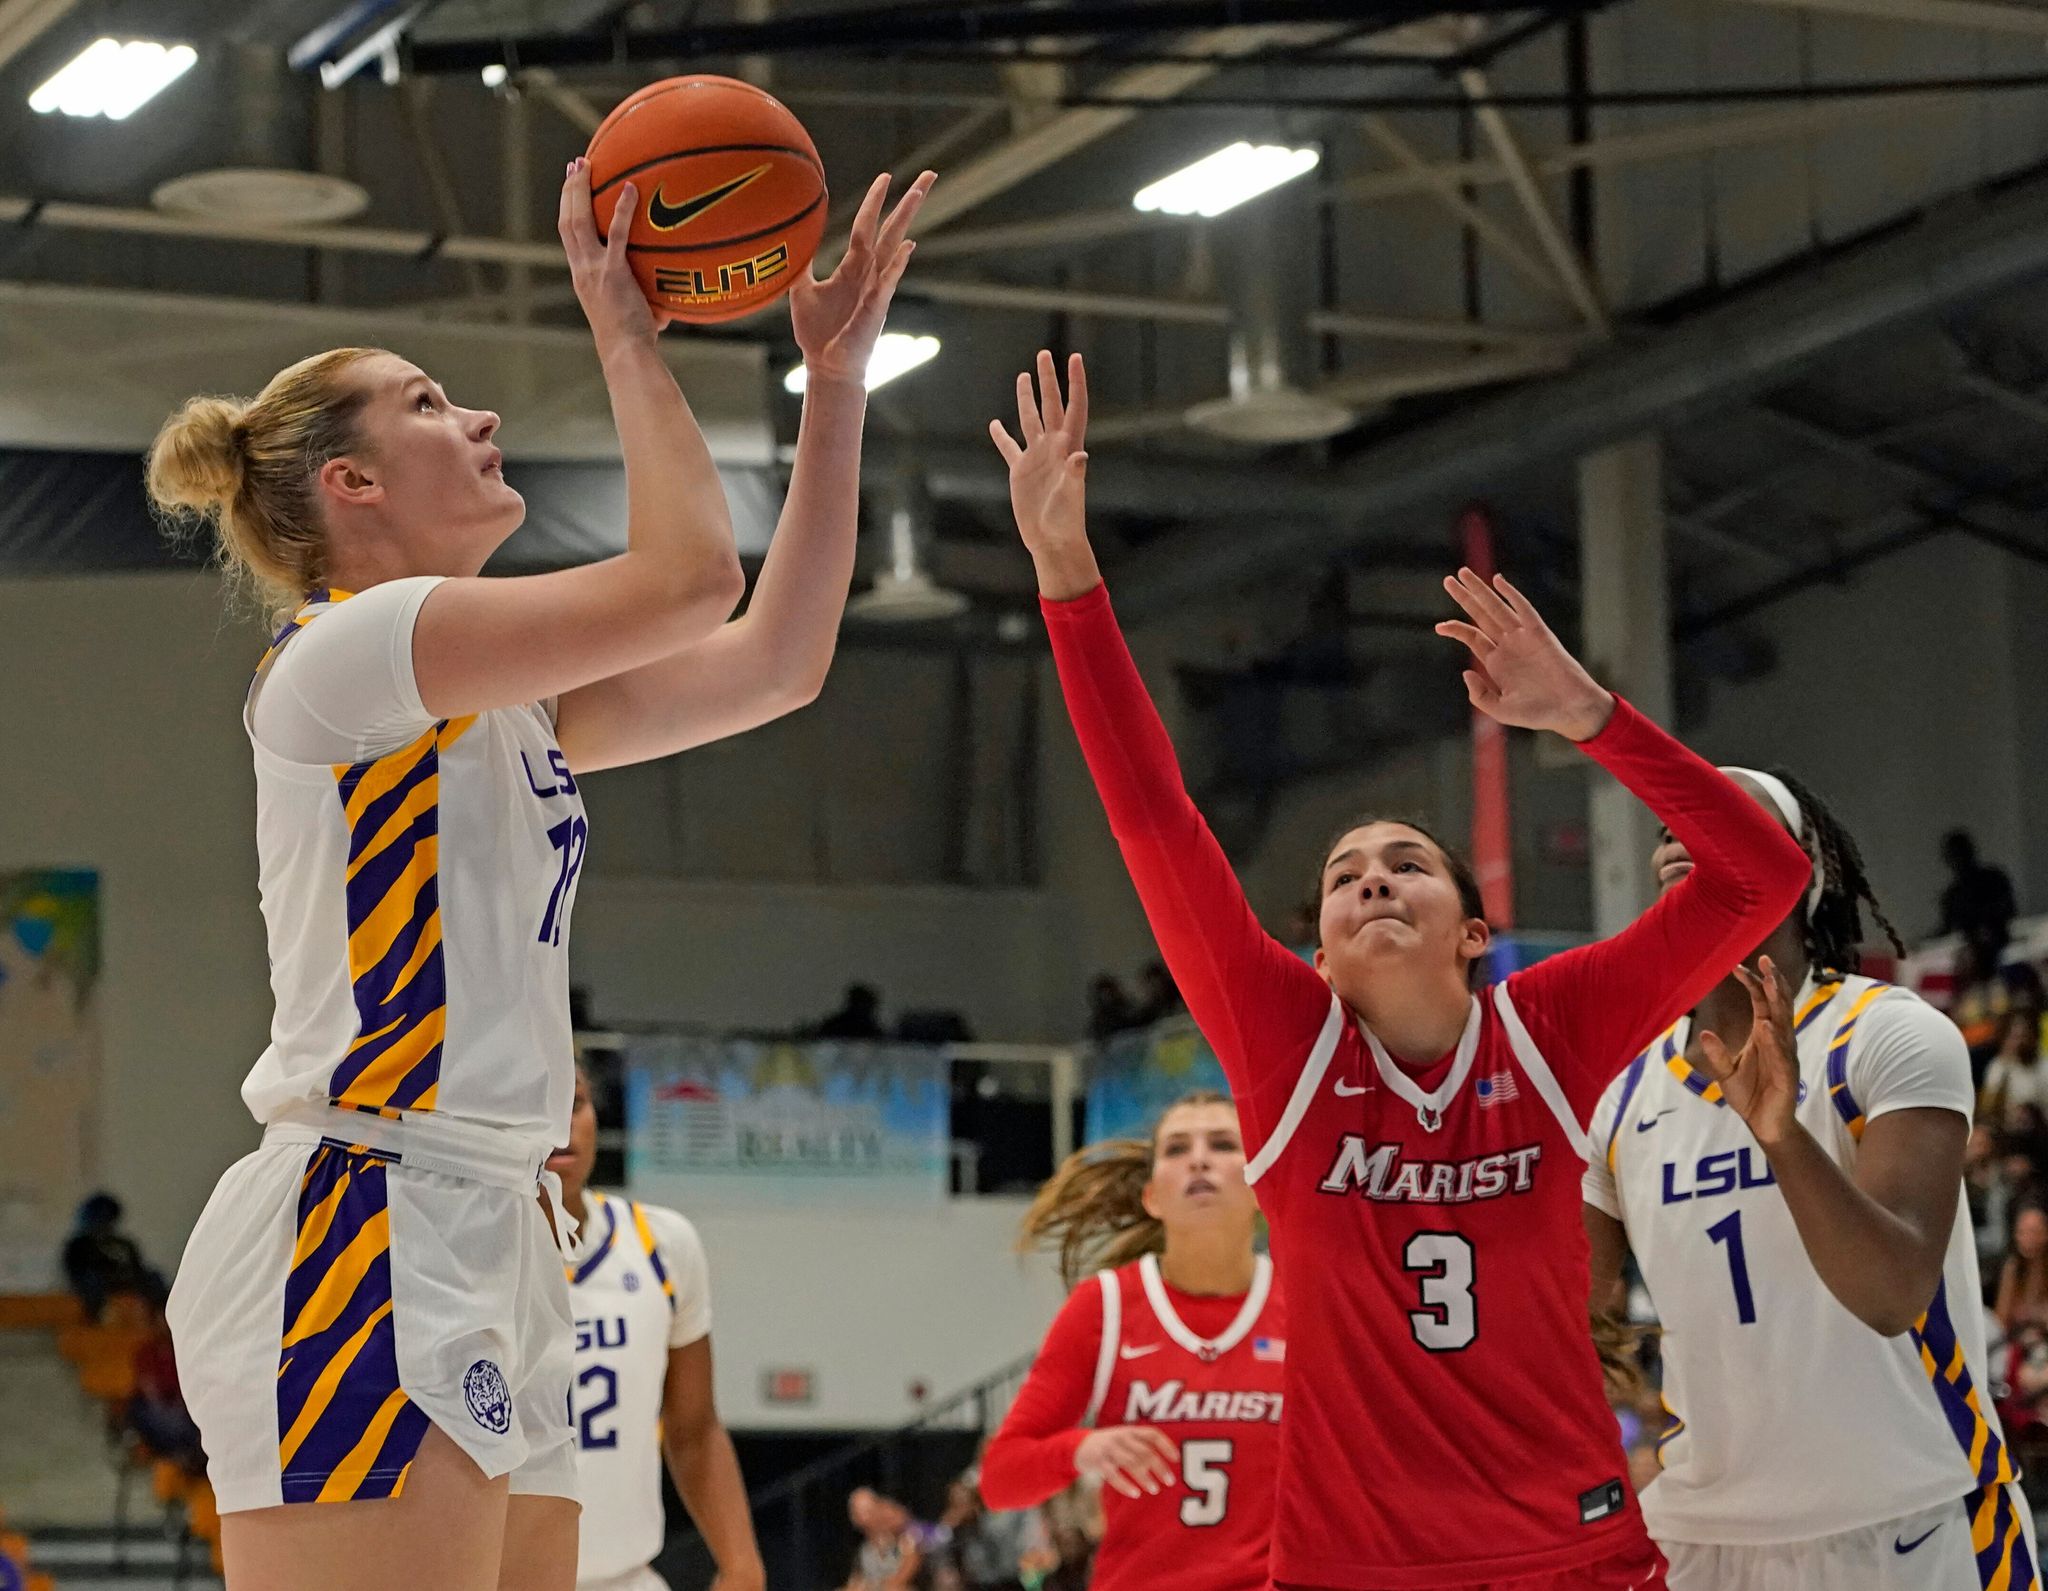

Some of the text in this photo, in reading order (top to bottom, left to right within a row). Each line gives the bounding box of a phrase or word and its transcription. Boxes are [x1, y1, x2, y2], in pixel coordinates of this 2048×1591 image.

[654, 241, 789, 297] ELITE
[520, 749, 577, 798] LS
[1317, 1133, 1542, 1204] MARIST
[1403, 1230, 1478, 1353] 3
[1706, 1209, 1756, 1325] 1
[575, 1317, 627, 1352] SU
[566, 1364, 617, 1450] 2
[1179, 1437, 1234, 1528] 5
